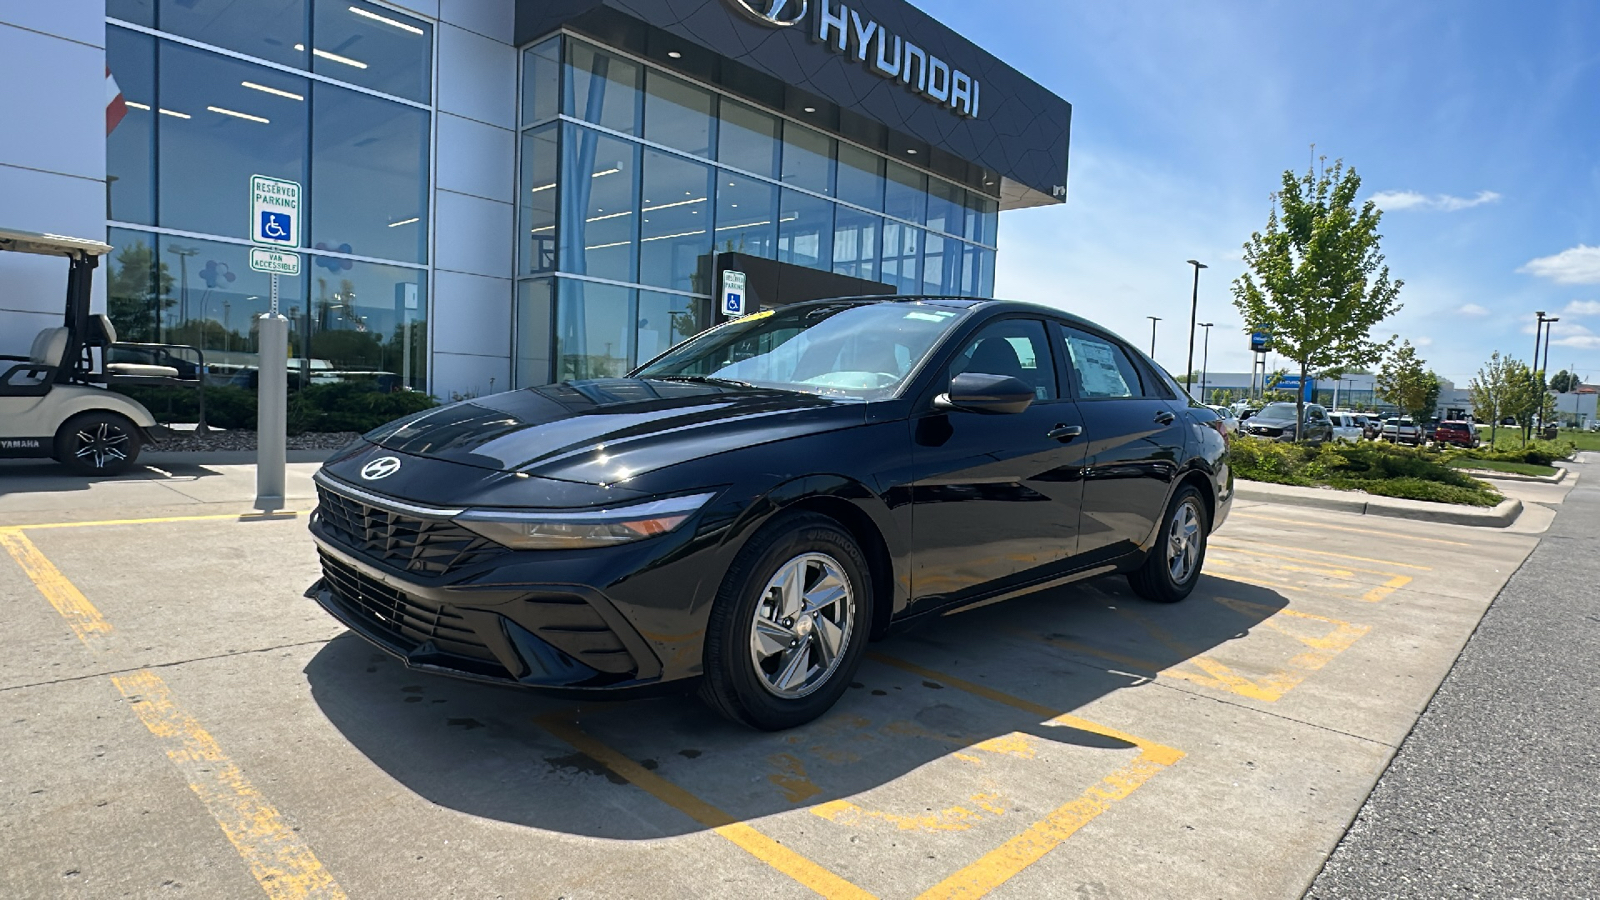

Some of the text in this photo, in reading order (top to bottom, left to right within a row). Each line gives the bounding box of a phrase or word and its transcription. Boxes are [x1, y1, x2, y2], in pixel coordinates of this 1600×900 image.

[819, 0, 980, 119] HYUNDAI
[256, 181, 296, 198] RESERVED
[256, 193, 296, 209] PARKING
[269, 253, 283, 262] VAN
[254, 260, 297, 271] ACCESSIBLE
[1, 440, 40, 448] YAMAHA
